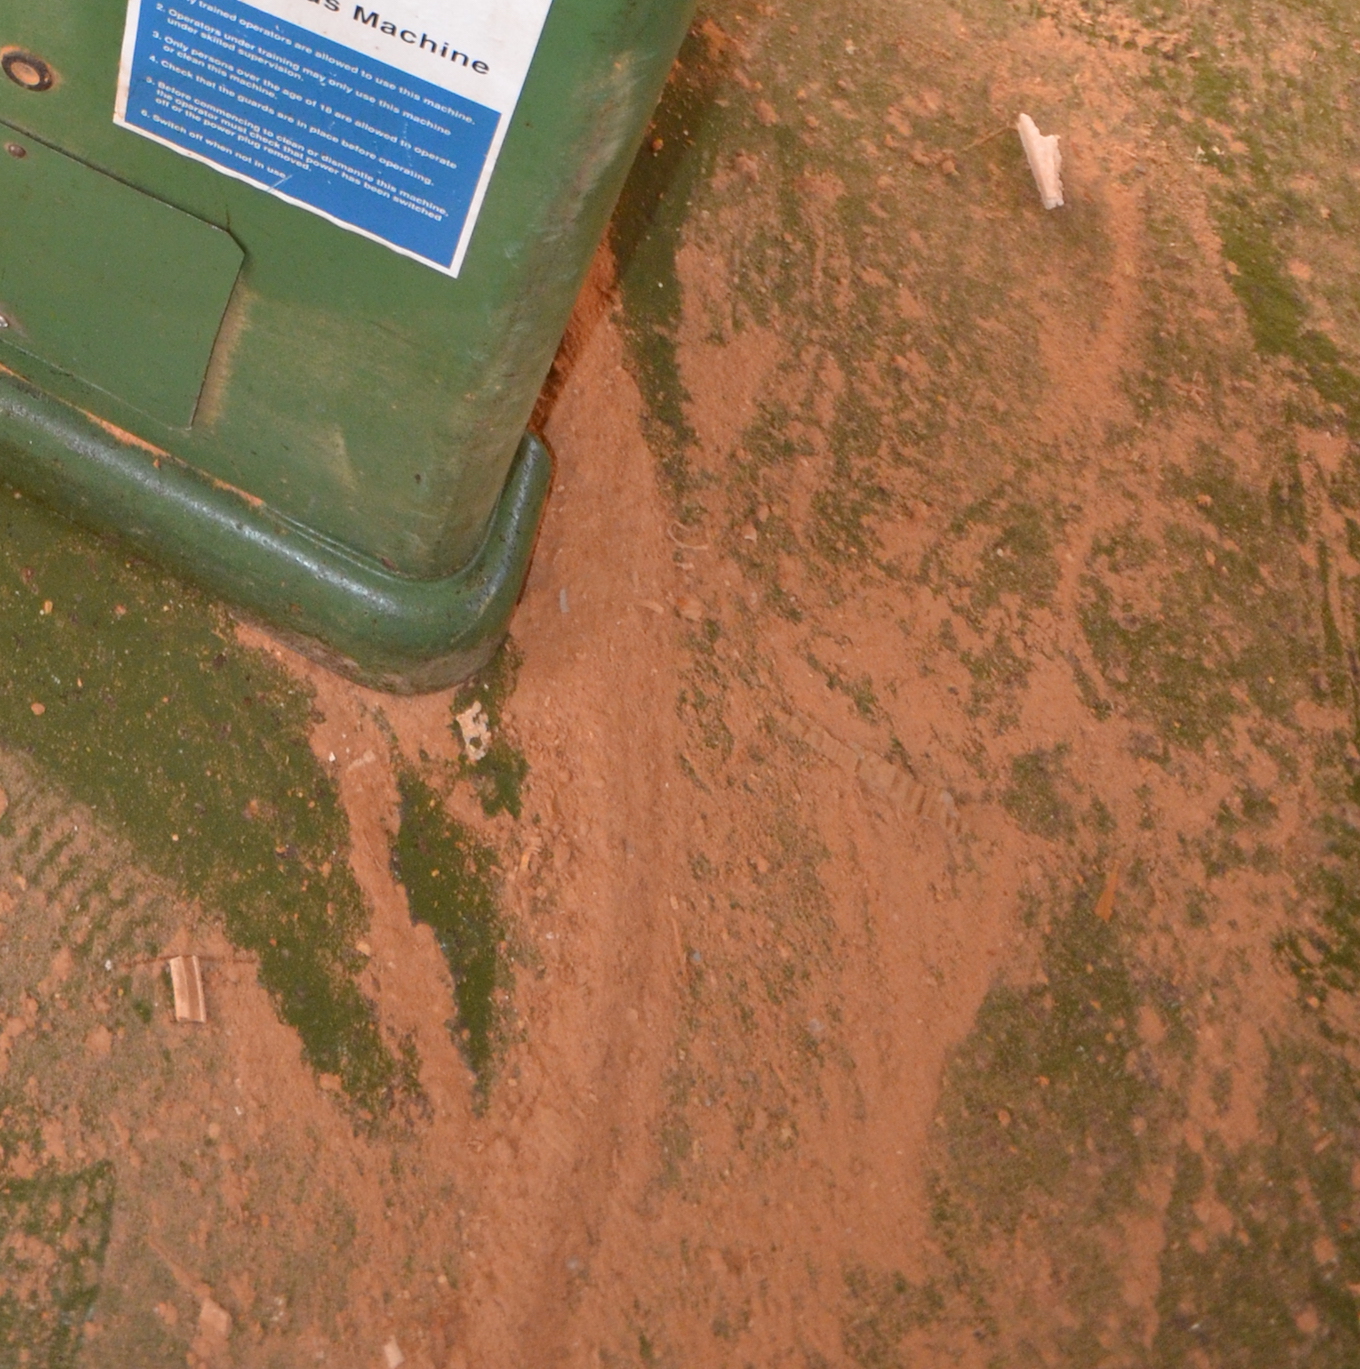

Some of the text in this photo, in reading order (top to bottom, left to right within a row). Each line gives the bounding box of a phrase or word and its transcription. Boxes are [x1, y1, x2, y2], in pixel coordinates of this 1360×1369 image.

[166, 16, 303, 81] under skilled supervision.
[168, 7, 222, 37] Operators
[224, 32, 256, 51] under
[256, 46, 300, 72] training
[302, 66, 326, 82] may
[328, 77, 354, 94] only
[354, 88, 376, 104] use
[378, 98, 400, 114] this
[402, 108, 452, 136] machine
[176, 50, 206, 68] clean
[206, 62, 228, 78] this
[228, 73, 277, 99] machine.
[198, 0, 238, 22] trained
[238, 16, 293, 46] operators
[294, 40, 314, 55] are
[314, 50, 360, 75] allowed
[374, 76, 397, 91] use
[398, 85, 422, 102] this
[422, 96, 476, 126] machine.
[353, 5, 490, 75] Machine
[152, 114, 187, 134] Switch
[188, 130, 204, 142] off
[204, 138, 233, 154] when
[234, 151, 252, 164] not
[154, 96, 170, 108] off
[184, 110, 202, 122] the
[202, 118, 236, 137] power
[237, 133, 262, 150] plug
[262, 144, 312, 172] removed.
[156, 88, 442, 222] the operator must check that power has been switched
[157, 80, 192, 102] Before
[193, 97, 260, 134] commencing
[276, 134, 306, 152] clean
[320, 154, 374, 183] dismantle
[376, 178, 397, 193] this
[160, 58, 194, 79] Check
[195, 74, 216, 89] that
[218, 84, 236, 98] the
[236, 93, 276, 115] guards
[276, 111, 294, 124] are
[308, 125, 340, 144] place
[340, 138, 378, 160] before
[378, 156, 434, 186] operating.
[164, 35, 189, 52] Only
[190, 47, 234, 72] persons
[236, 67, 260, 83] over
[262, 78, 280, 92] the
[282, 88, 304, 102] age
[334, 110, 353, 124] are
[354, 119, 398, 144] allowed
[413, 146, 458, 170] operate
